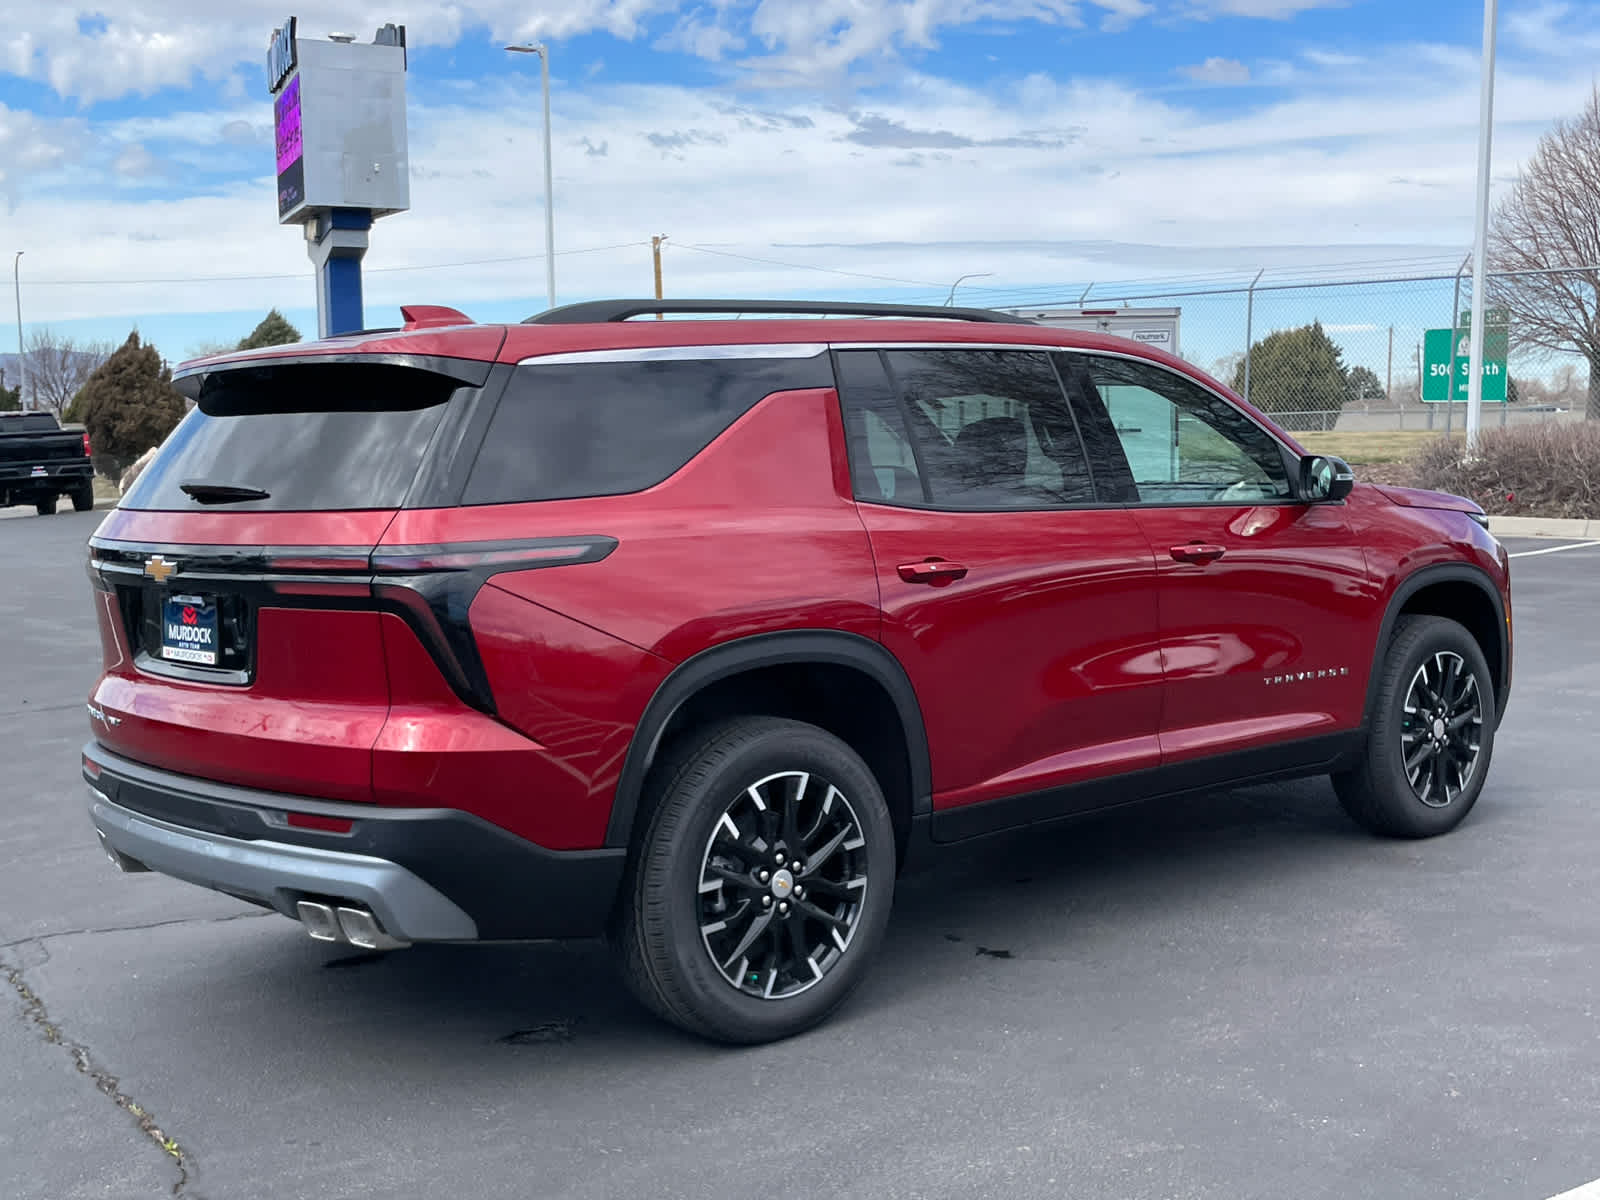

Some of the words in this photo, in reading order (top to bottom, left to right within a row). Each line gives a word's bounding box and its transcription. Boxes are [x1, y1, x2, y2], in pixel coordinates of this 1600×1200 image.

[1461, 363, 1499, 376] Sth
[169, 624, 211, 643] MURDOCK
[1264, 667, 1348, 685] TRAVERSE
